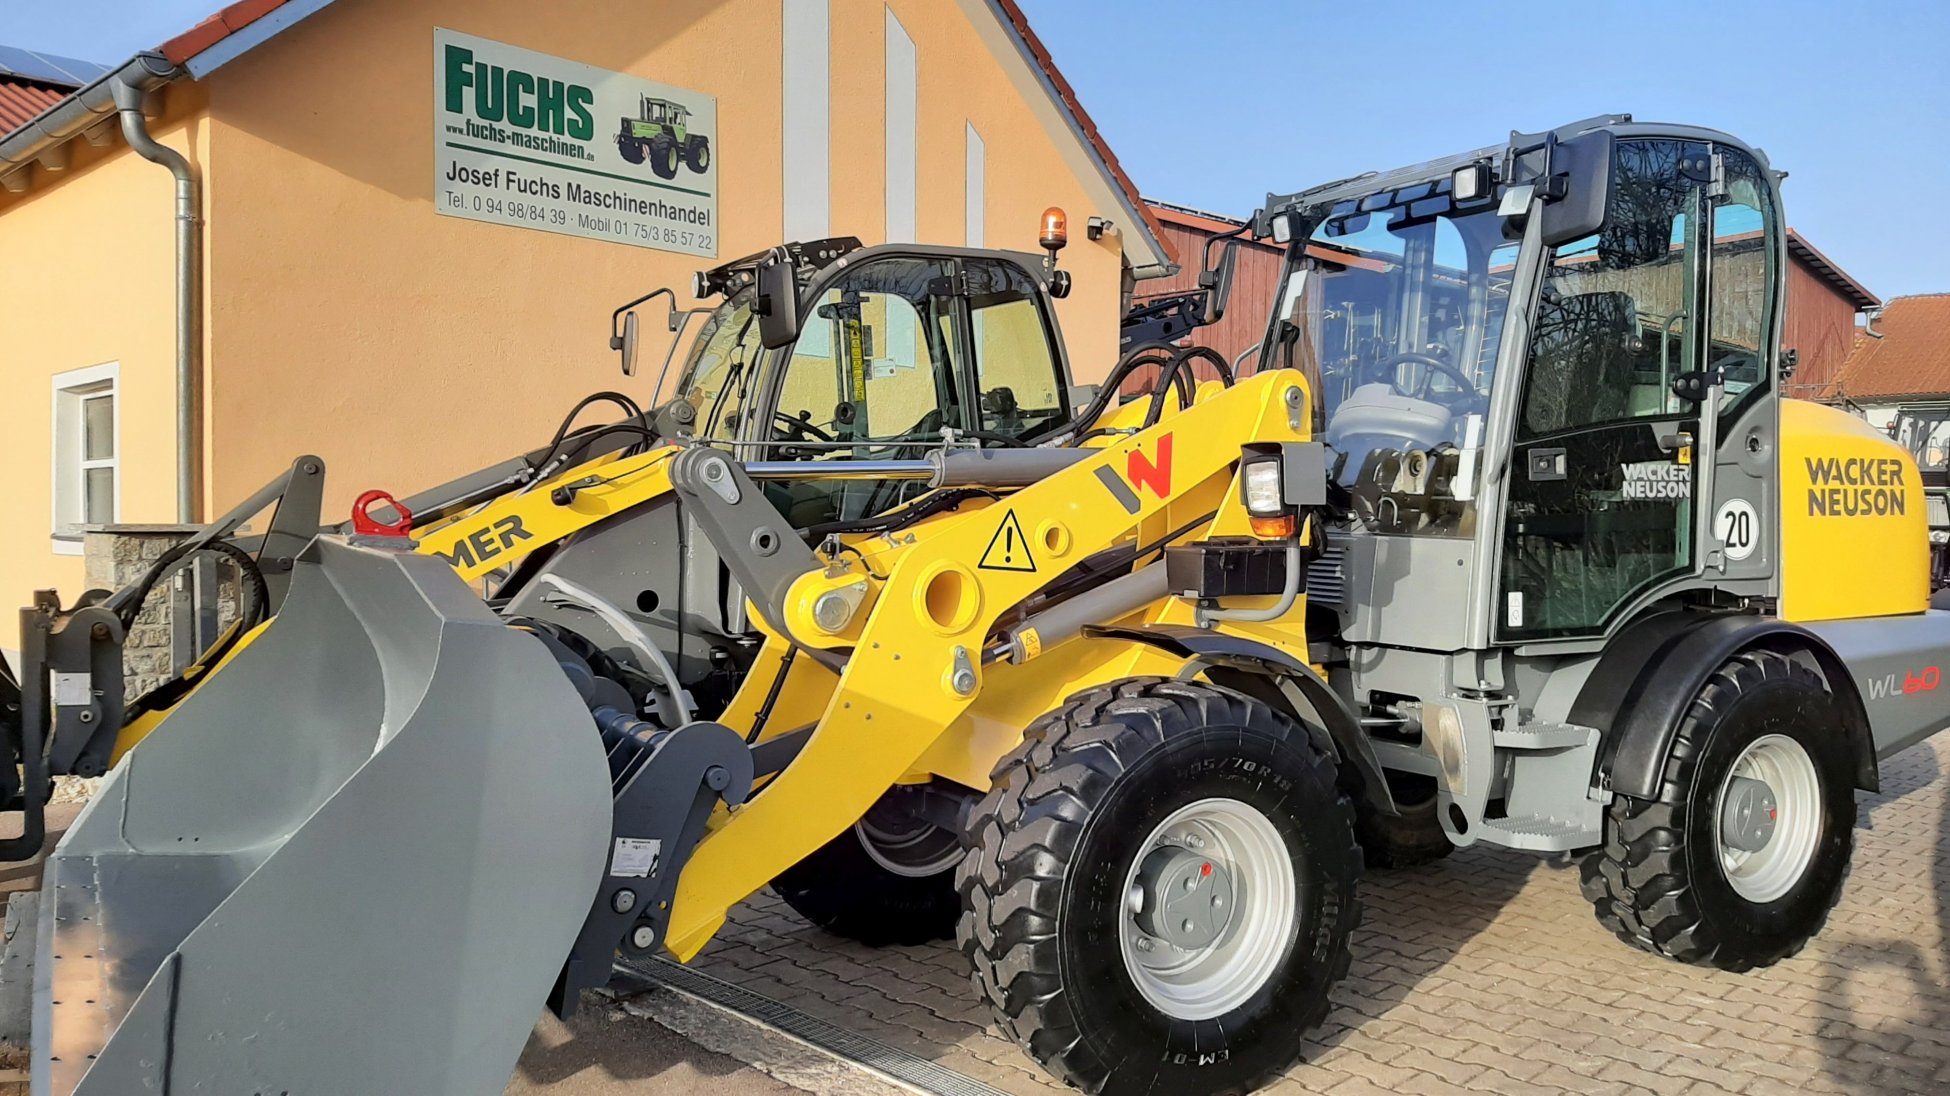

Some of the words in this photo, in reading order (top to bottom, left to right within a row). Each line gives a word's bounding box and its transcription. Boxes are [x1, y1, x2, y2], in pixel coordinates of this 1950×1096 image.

[445, 44, 593, 141] FUCHS
[446, 118, 595, 161] www.fuchs-maschinen.de
[446, 160, 499, 189] Josef
[506, 170, 561, 200] Fuchs
[567, 182, 710, 227] Maschinenhandel
[445, 190, 468, 210] Tel.
[473, 195, 482, 212] 0
[486, 197, 502, 215] 94
[507, 201, 545, 222] 98/84
[550, 208, 566, 225] 39
[578, 213, 611, 232] Mobil
[614, 219, 628, 235] 01
[633, 222, 660, 241] 75/3
[663, 228, 677, 244] 85
[680, 231, 695, 247] 57
[698, 234, 712, 250] 22
[1621, 463, 1690, 481] WACKER
[1622, 481, 1690, 498] NEUSON
[1804, 457, 1904, 486] WACKER
[1807, 488, 1905, 516] NEUSON
[1725, 510, 1750, 549] 20
